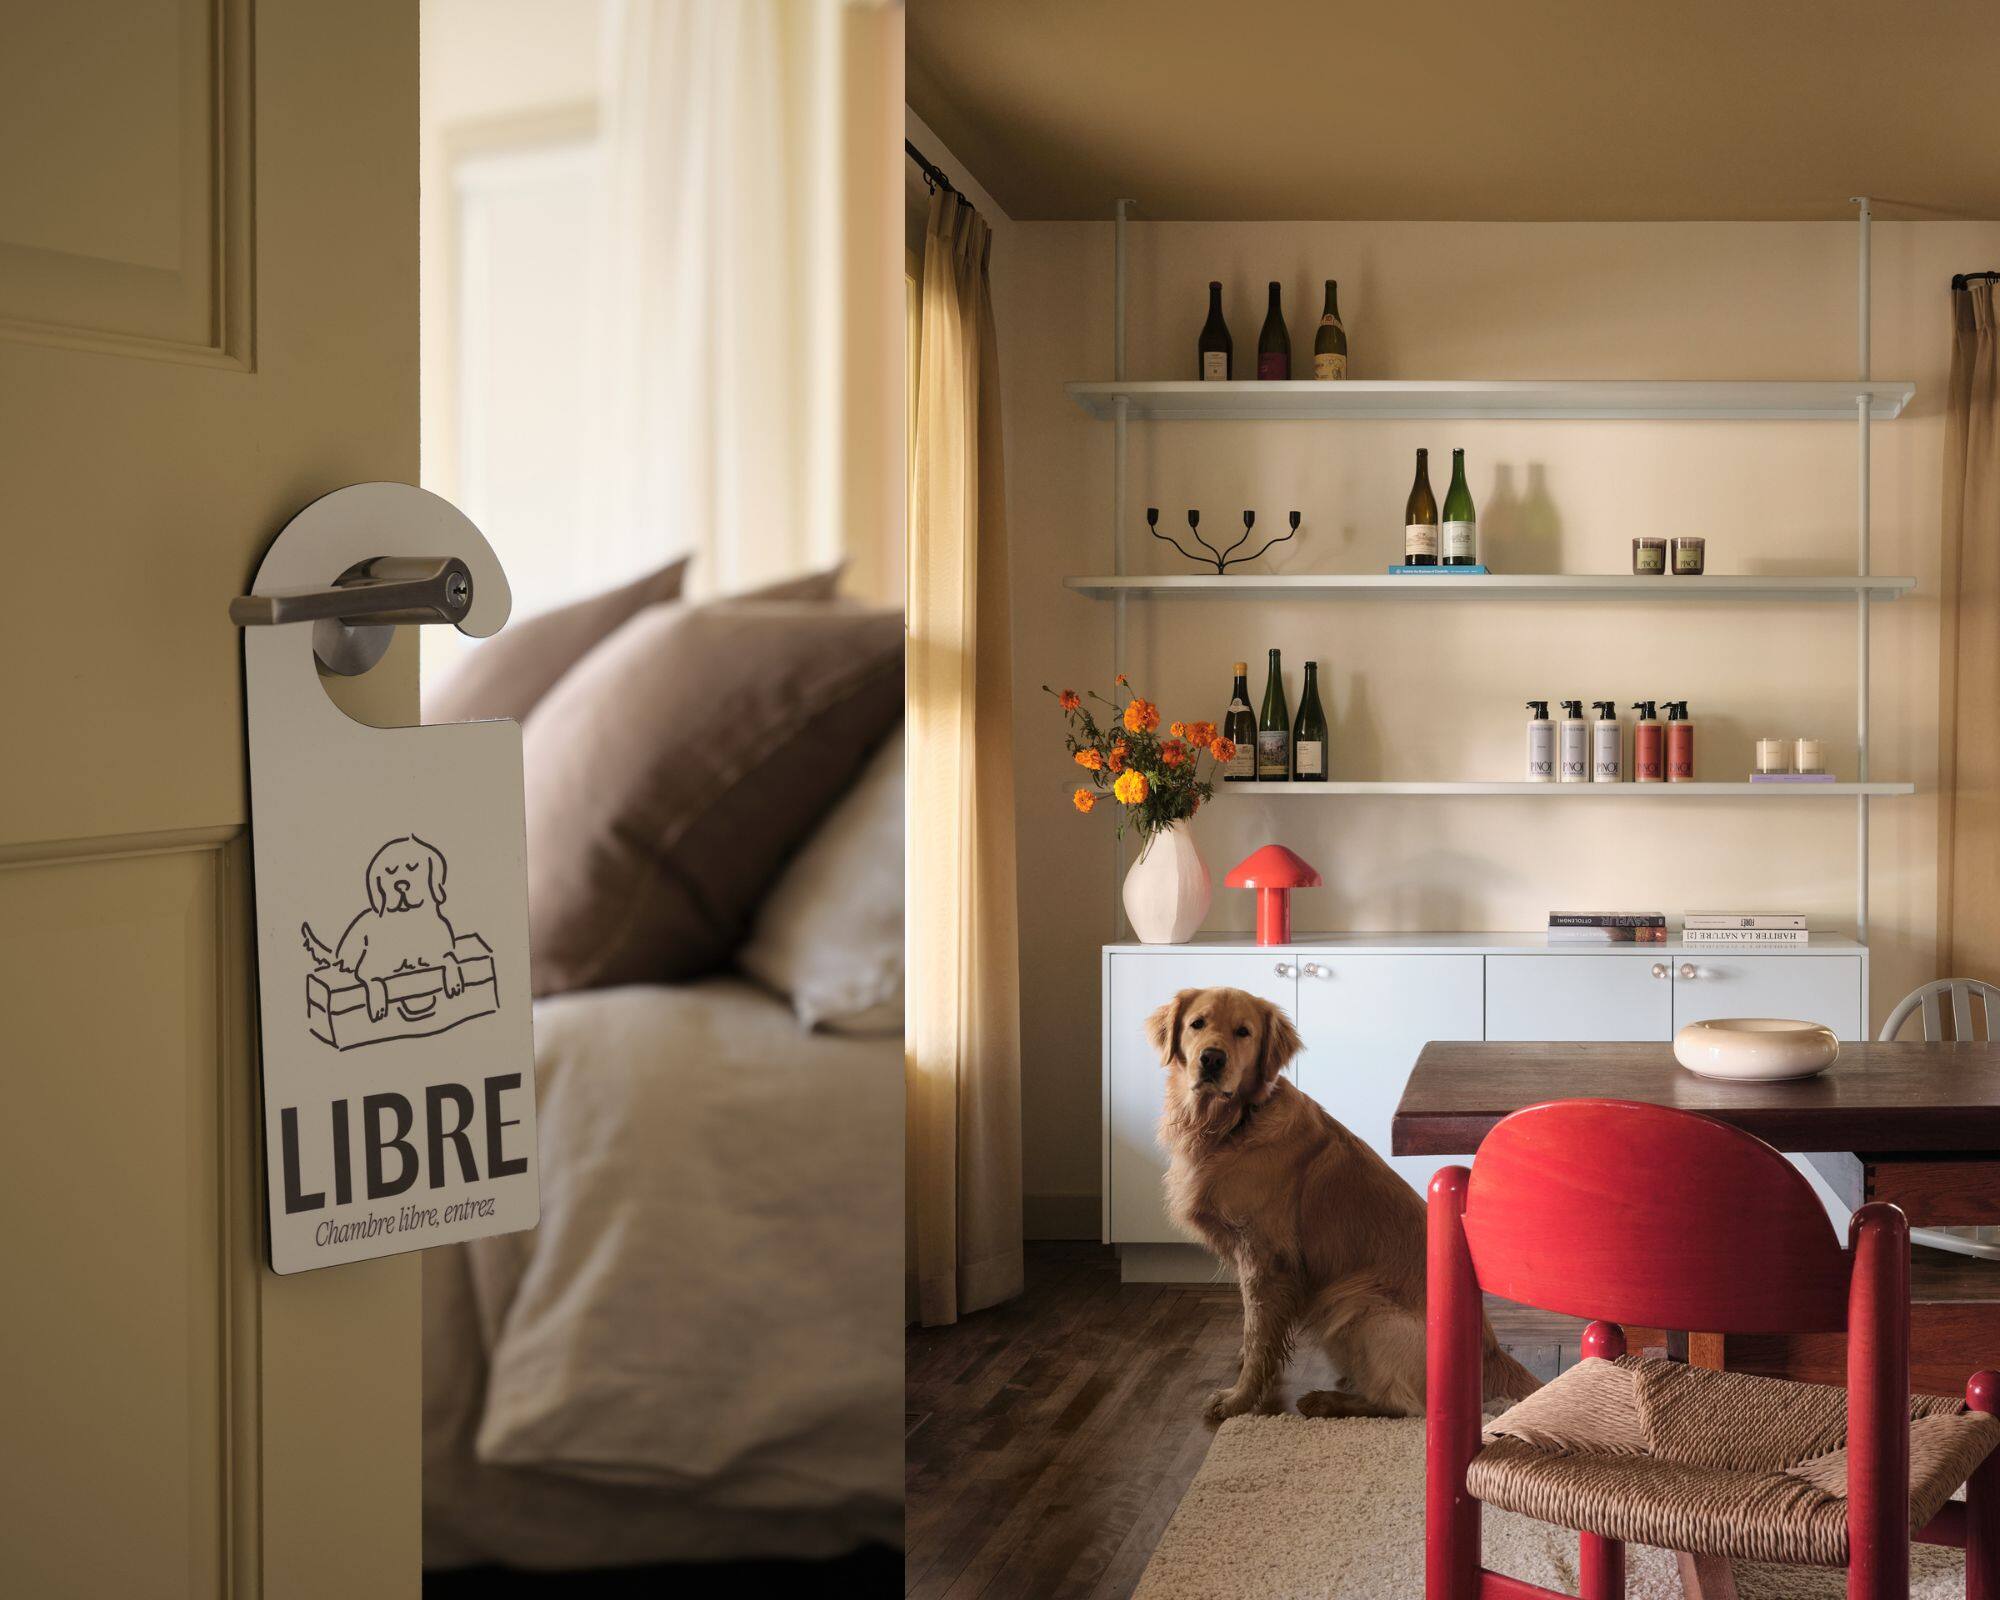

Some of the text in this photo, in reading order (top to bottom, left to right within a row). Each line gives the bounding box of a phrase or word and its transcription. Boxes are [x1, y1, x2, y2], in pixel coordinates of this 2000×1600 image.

[1699, 931, 1738, 940] NATURE
[1740, 931, 1753, 940] LA
[1755, 931, 1797, 940] HABITER
[281, 1072, 528, 1214] LIBRE
[315, 1197, 496, 1247] Chambre libre, entrez
